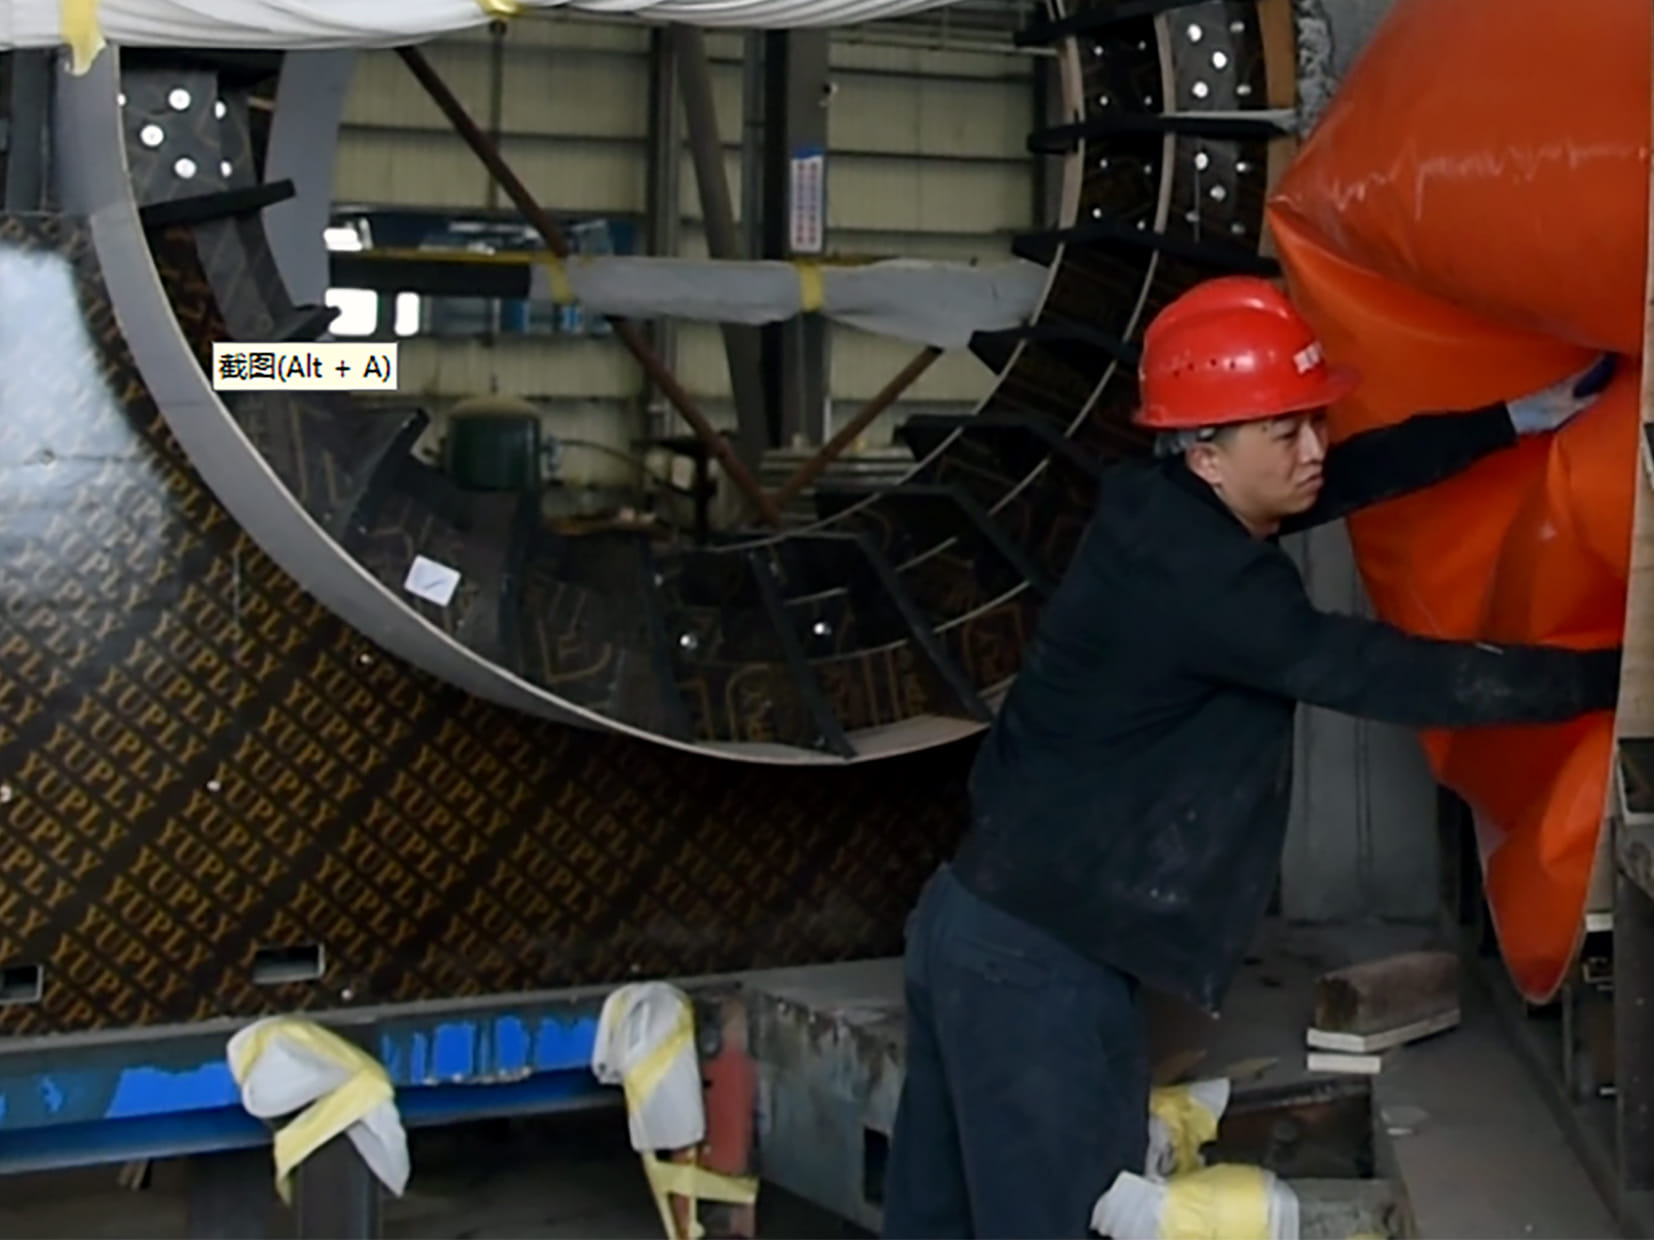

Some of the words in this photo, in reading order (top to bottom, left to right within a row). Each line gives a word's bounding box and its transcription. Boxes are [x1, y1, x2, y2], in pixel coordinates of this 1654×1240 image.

[153, 611, 258, 708] YUPLY
[180, 584, 281, 680] YUPLY
[100, 666, 206, 765] YUPLY
[127, 638, 231, 736] YUPLY
[286, 680, 389, 773] YUPLY
[311, 653, 411, 746] YUPLY
[45, 724, 155, 822] YUPLY
[73, 695, 182, 792] YUPLY
[236, 733, 338, 829] YUPLY
[261, 707, 362, 800] YUPLY
[411, 744, 511, 838] YUPLY
[18, 751, 128, 850] YUPLY
[183, 790, 289, 885] YUPLY
[214, 764, 313, 856] YUPLY
[365, 797, 466, 891] YUPLY
[390, 770, 489, 865] YUPLY
[131, 847, 240, 942] YUPLY
[157, 818, 262, 912] YUPLY
[316, 854, 416, 944] YUPLY
[341, 825, 442, 919] YUPLY
[77, 906, 187, 1000] YUPLY
[105, 876, 214, 971] YUPLY
[52, 934, 160, 1026] YUPLY
